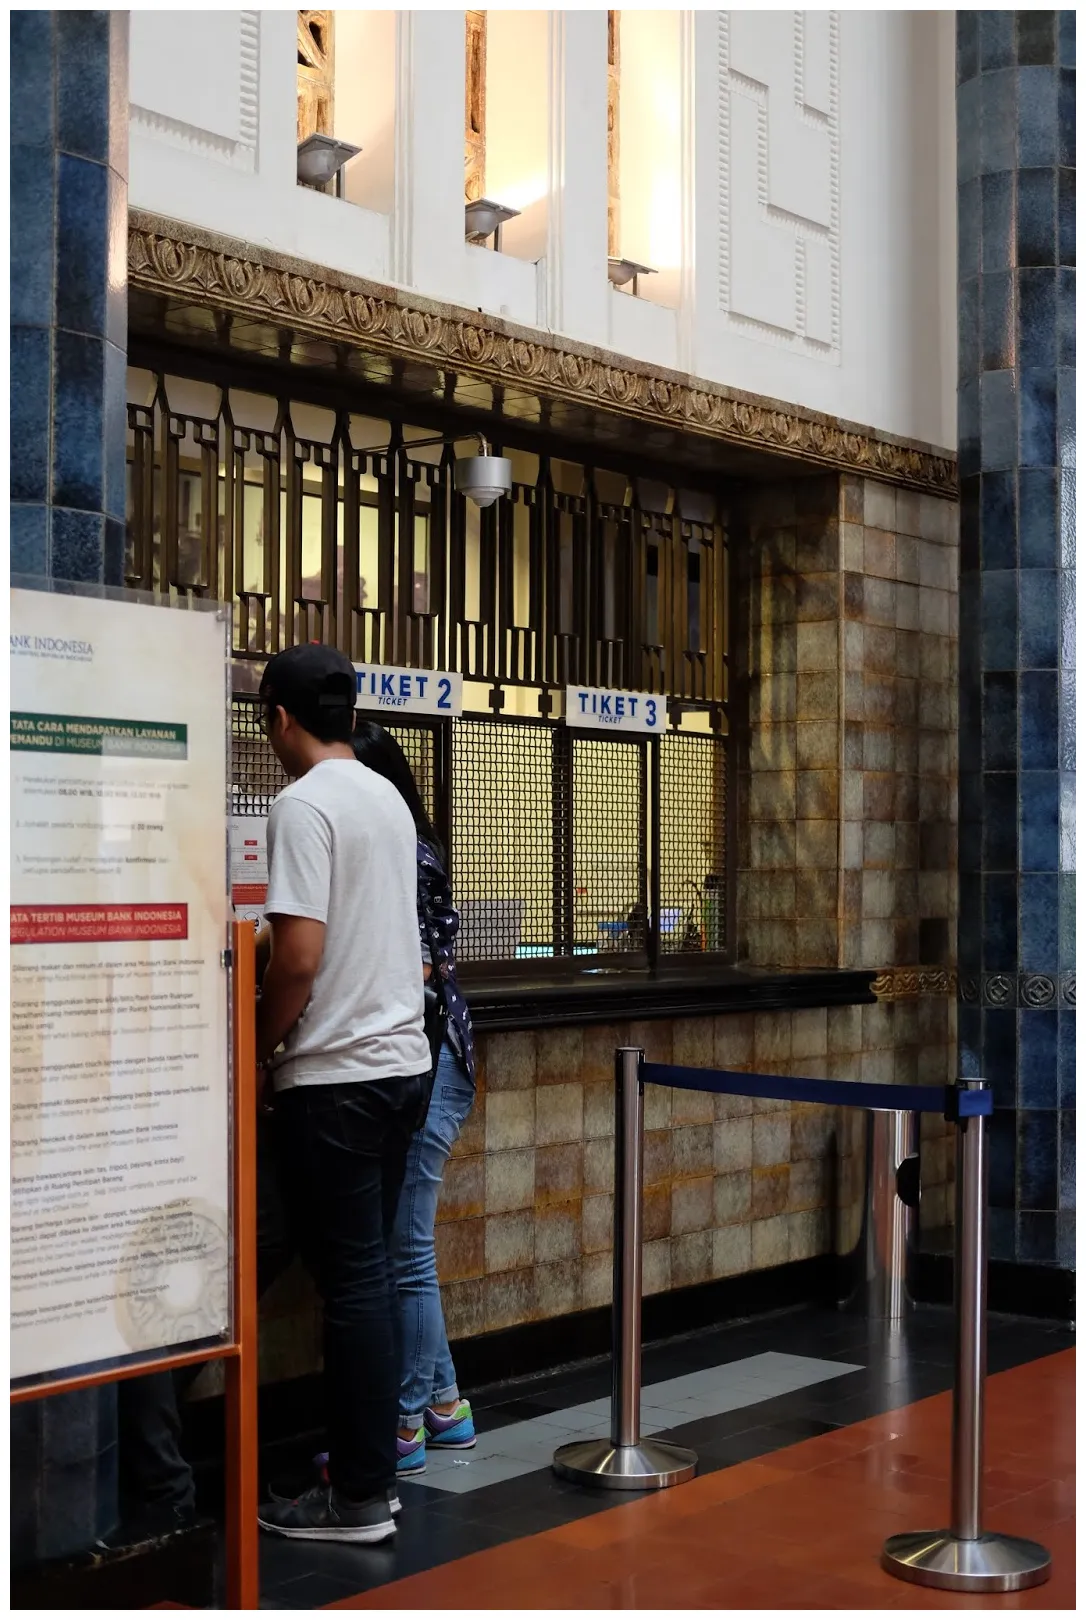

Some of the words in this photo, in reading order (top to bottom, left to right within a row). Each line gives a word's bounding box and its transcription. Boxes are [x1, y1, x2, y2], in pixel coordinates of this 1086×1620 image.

[34, 636, 93, 654] INDONESIA
[356, 672, 428, 697] TIKET
[437, 679, 451, 708] 2
[378, 697, 408, 706] TICKET
[578, 693, 638, 716] TIKET
[645, 700, 656, 726] 3
[598, 715, 622, 723] TICKET
[11, 719, 34, 731] TATA
[36, 720, 64, 732] CARA
[65, 723, 134, 738] MENDAPATKAN
[135, 727, 176, 740] LAYANAN
[54, 735, 65, 746] DI
[30, 911, 64, 923] TERTIB
[66, 911, 105, 922] MUSEUM
[106, 911, 132, 922] BANK
[133, 910, 182, 921] INDONESIA
[66, 925, 107, 936] MUSEUM
[107, 924, 132, 936] BANK
[133, 923, 182, 934] INDONESIA
